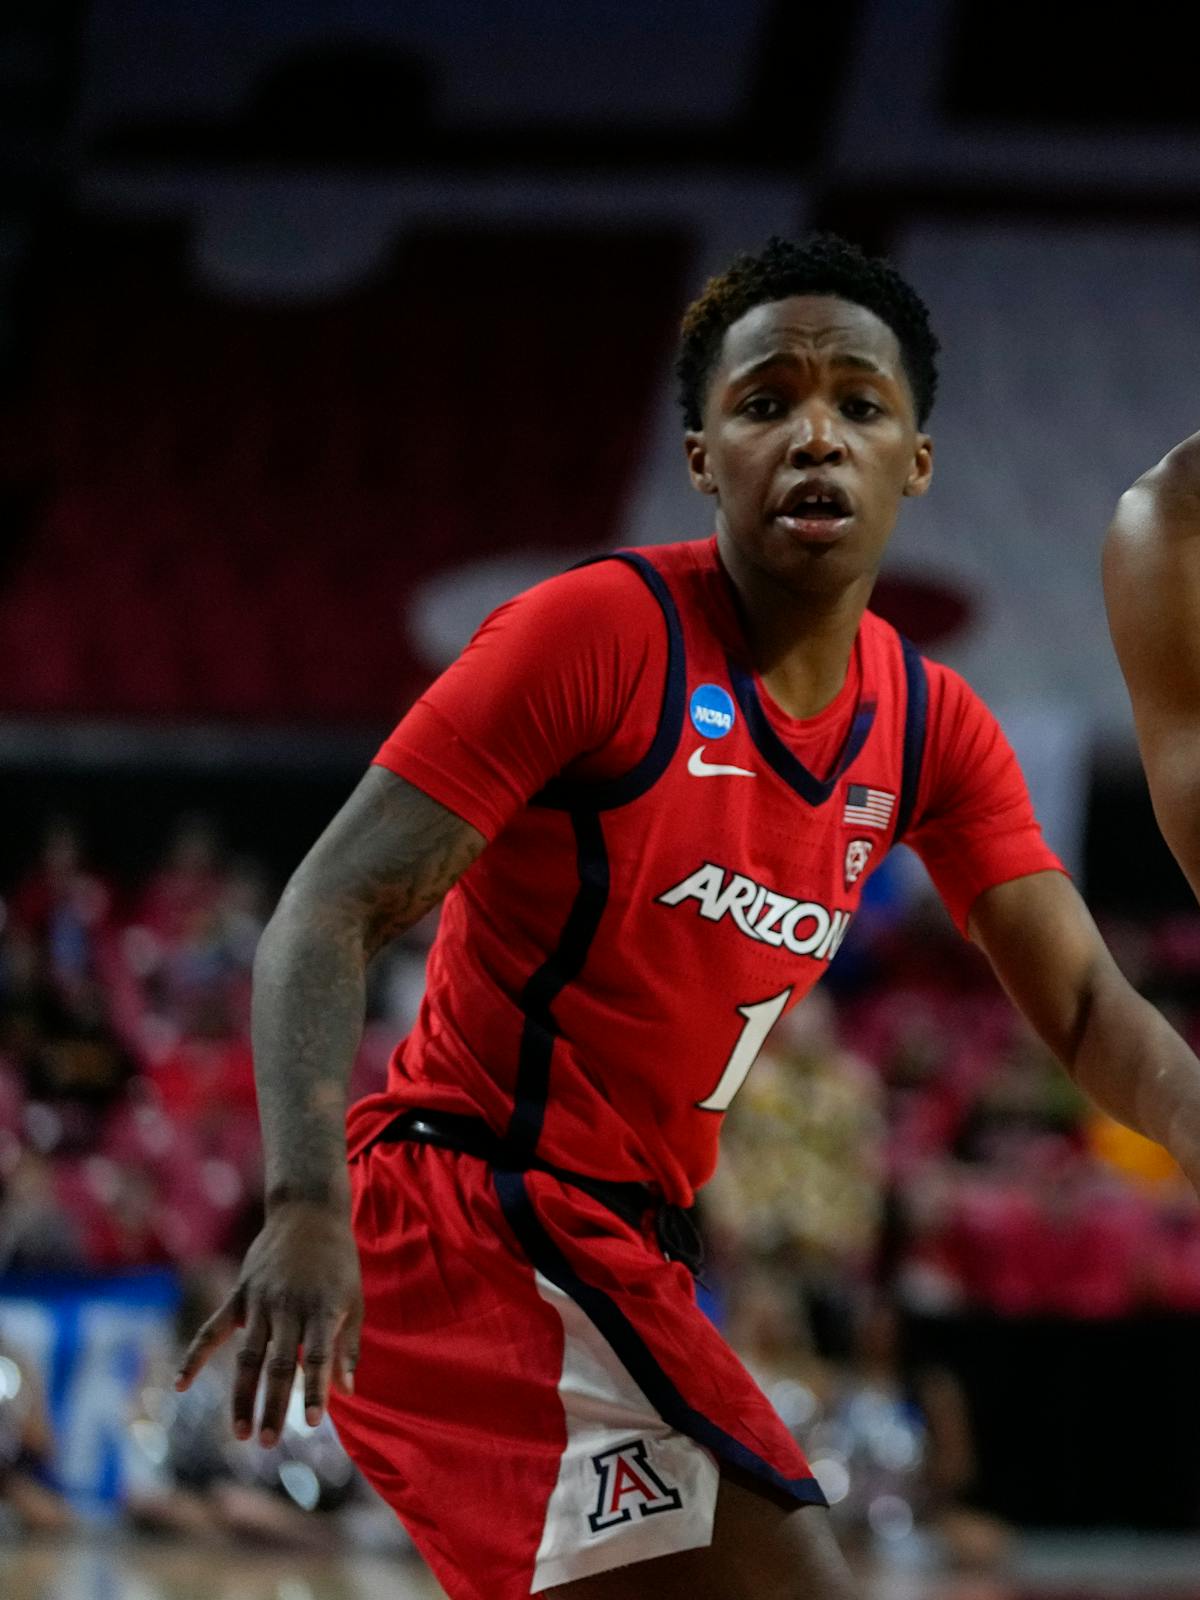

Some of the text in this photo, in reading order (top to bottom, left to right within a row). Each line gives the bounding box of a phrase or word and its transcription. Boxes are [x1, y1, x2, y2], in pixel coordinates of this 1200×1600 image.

[695, 705, 731, 730] NCAA
[695, 984, 794, 1112] 1
[588, 1440, 682, 1532] A
